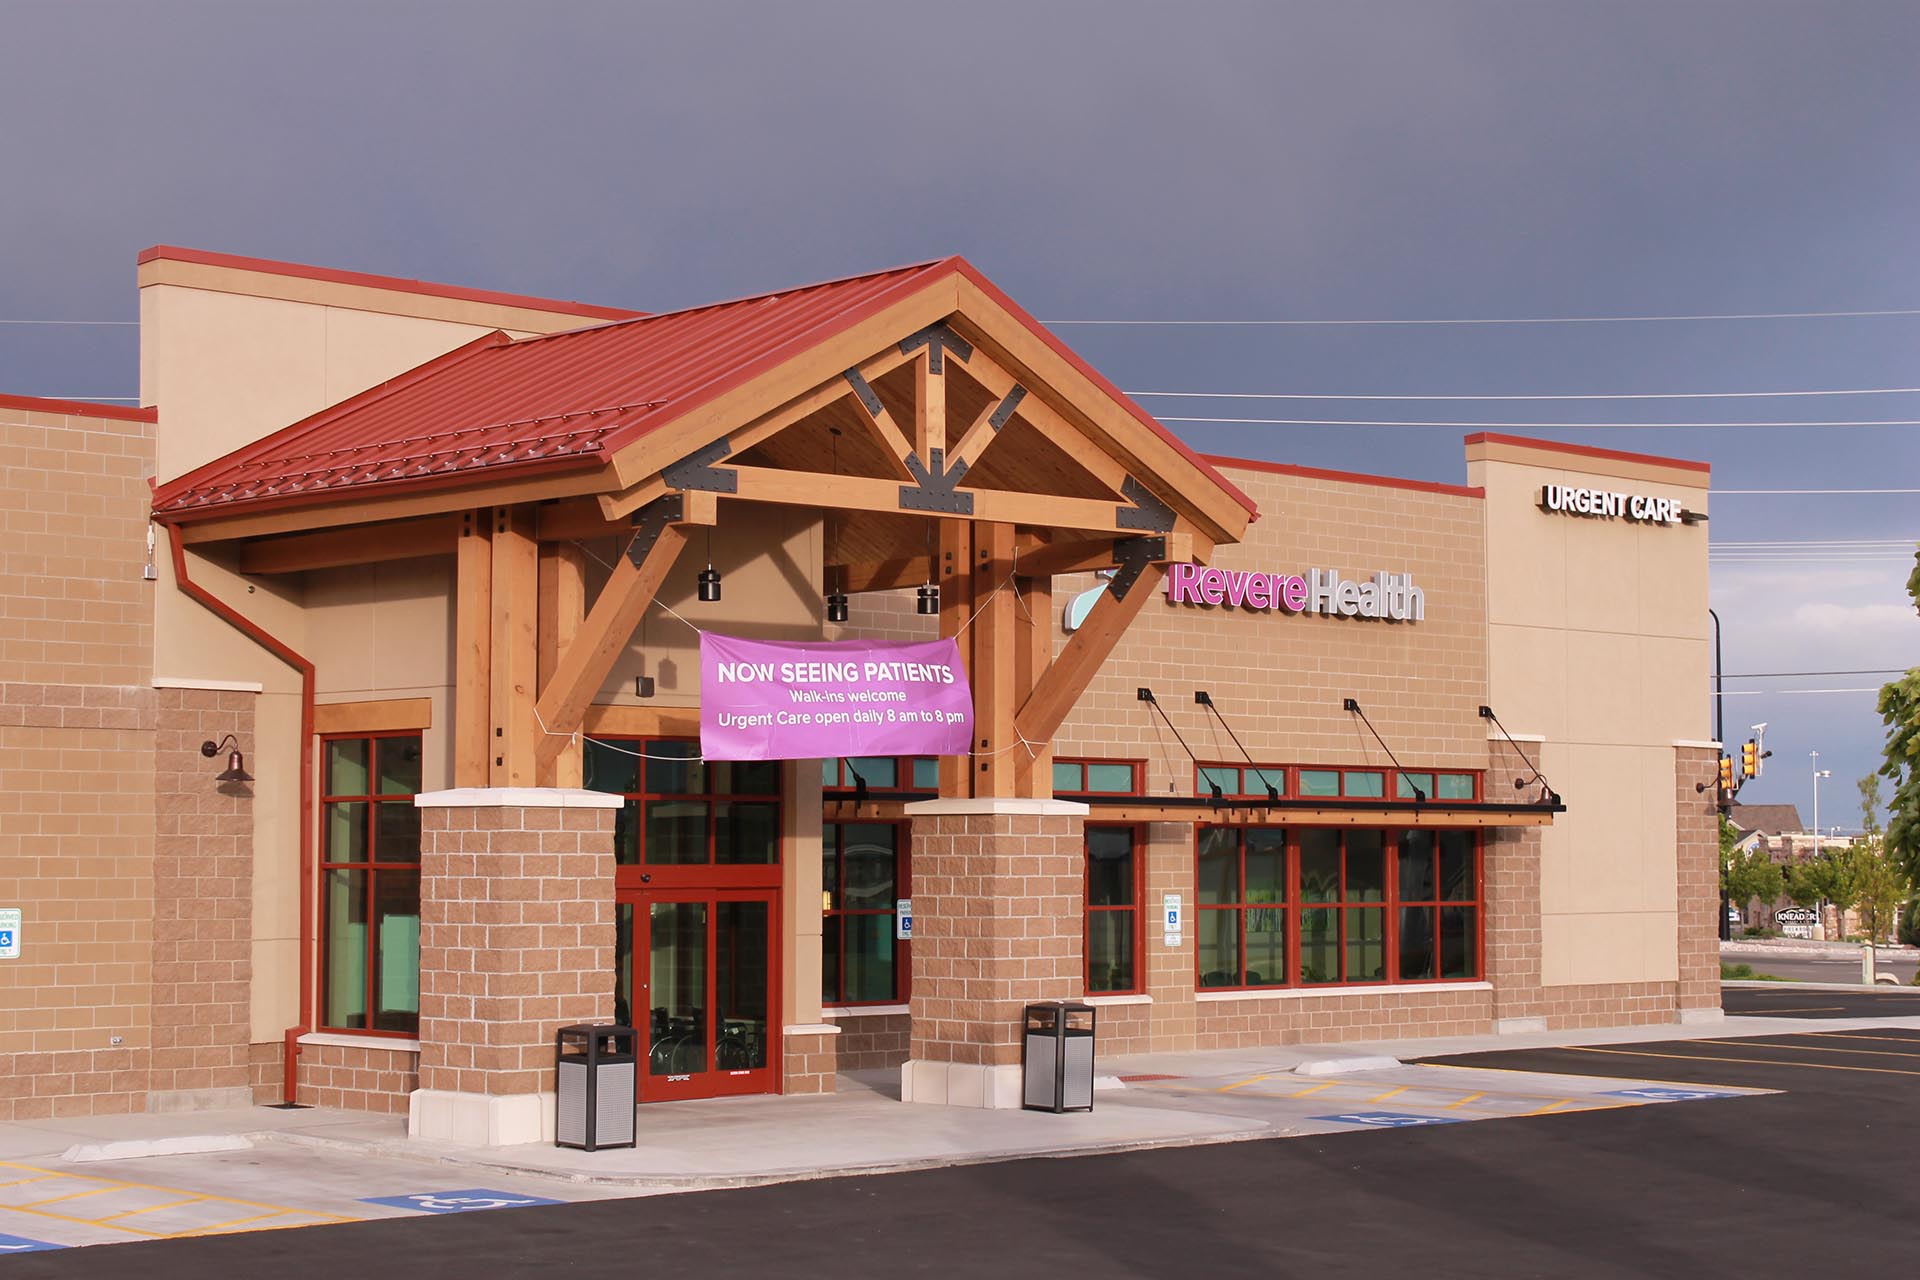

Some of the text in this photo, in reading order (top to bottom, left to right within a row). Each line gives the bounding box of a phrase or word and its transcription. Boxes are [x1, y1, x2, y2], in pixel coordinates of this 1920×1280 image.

[1543, 485, 1683, 523] URGENT CARE
[718, 662, 954, 684] NOW SEEING PATIENTS
[789, 689, 907, 703] Walk-ins welcome
[718, 708, 965, 729] Urgent Care open daily 8 am to 8 pm
